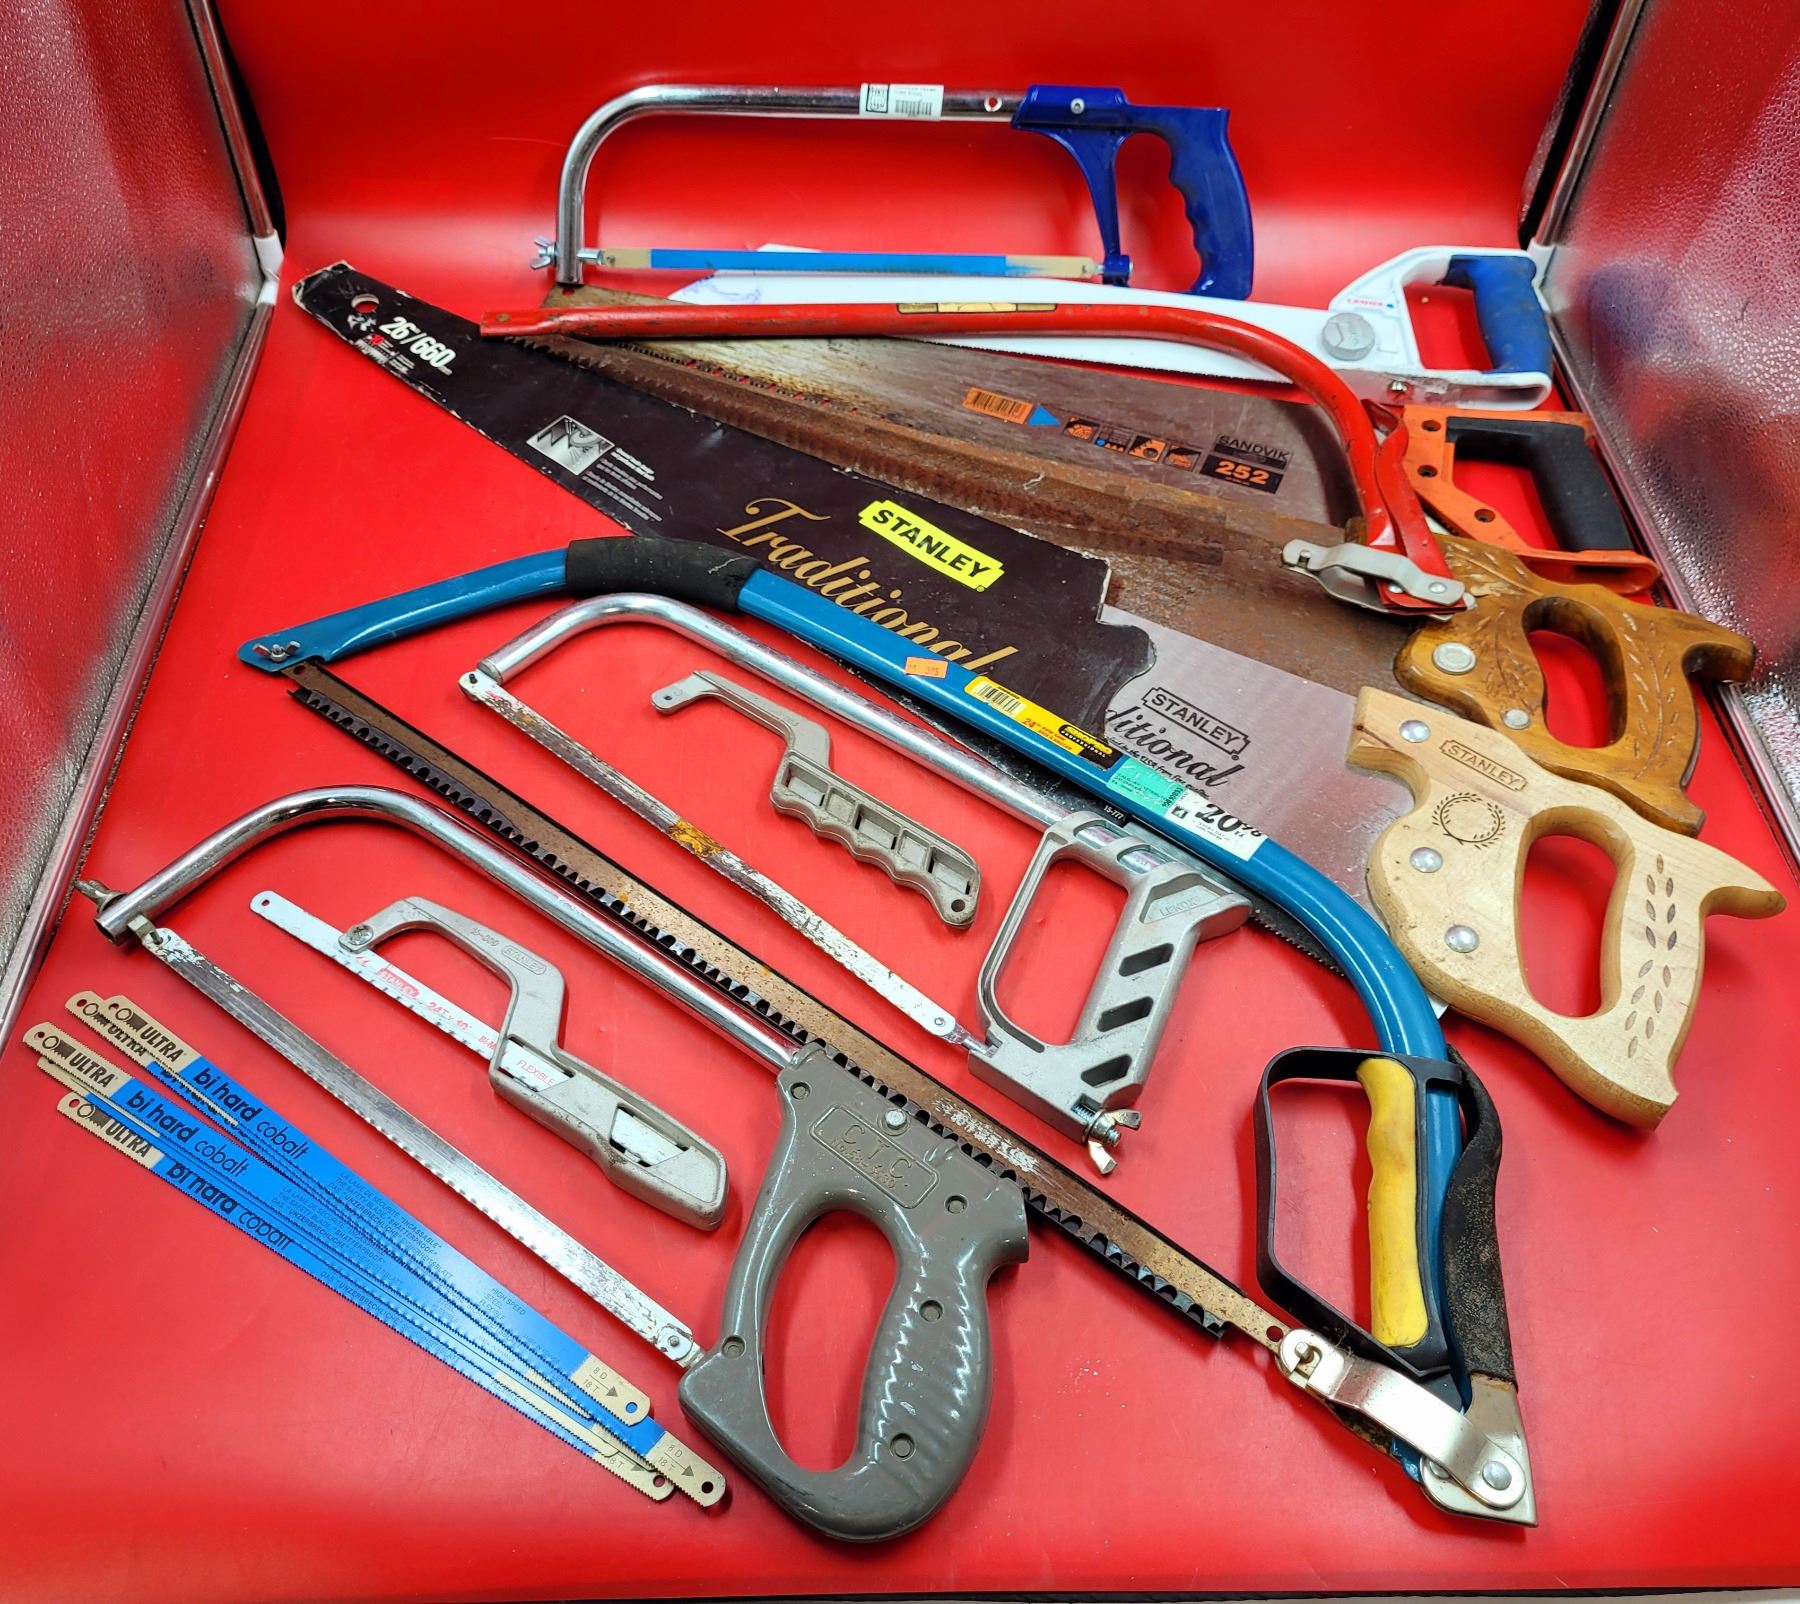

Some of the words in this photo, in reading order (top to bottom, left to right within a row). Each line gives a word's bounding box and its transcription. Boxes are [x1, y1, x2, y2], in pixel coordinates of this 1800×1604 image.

[1219, 436, 1289, 462] SANDVIK
[1215, 461, 1271, 486] 252
[872, 508, 992, 579] STANLEY
[1151, 693, 1240, 746] STANLEY
[1106, 706, 1245, 787] ditional
[1448, 744, 1520, 785] STANLEY
[1103, 805, 1125, 820] 15-777
[504, 947, 543, 972] STANLEY
[379, 970, 415, 995] STANLEY
[516, 1059, 556, 1086] FLEXIBLE
[140, 1026, 187, 1062] ULTRA
[193, 1067, 217, 1091] bi
[211, 1079, 261, 1122] hard
[256, 1121, 309, 1161] cobalt
[69, 1052, 116, 1088] ULTRA
[127, 1091, 149, 1113] bi
[147, 1101, 199, 1142] hard
[194, 1138, 248, 1177] cobalt
[105, 1122, 152, 1158] ULTRA
[490, 1288, 506, 1300] HIGH
[506, 1299, 526, 1314] SPEED
